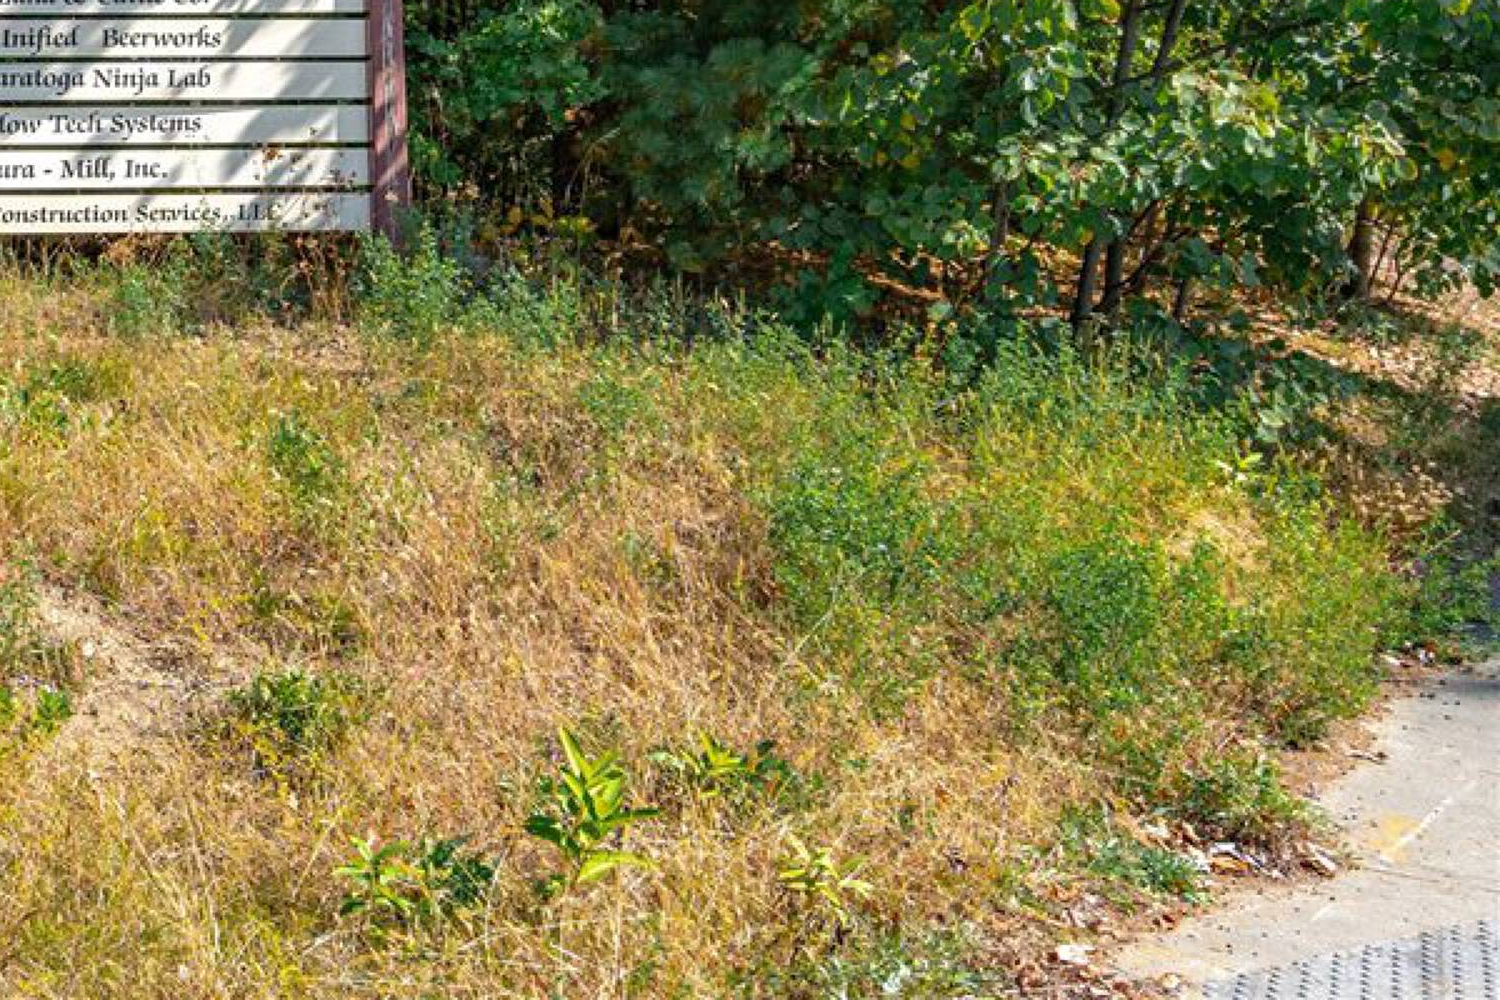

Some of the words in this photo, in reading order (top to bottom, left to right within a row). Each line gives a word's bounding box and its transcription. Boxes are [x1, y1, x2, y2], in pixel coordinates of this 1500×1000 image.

[101, 27, 221, 49] Beerworks
[93, 69, 160, 93] Ninja
[167, 69, 211, 88] Lab
[50, 113, 101, 134] Tech
[109, 114, 202, 139] Systems
[60, 158, 116, 183] Mill,
[124, 159, 168, 179] Inc.
